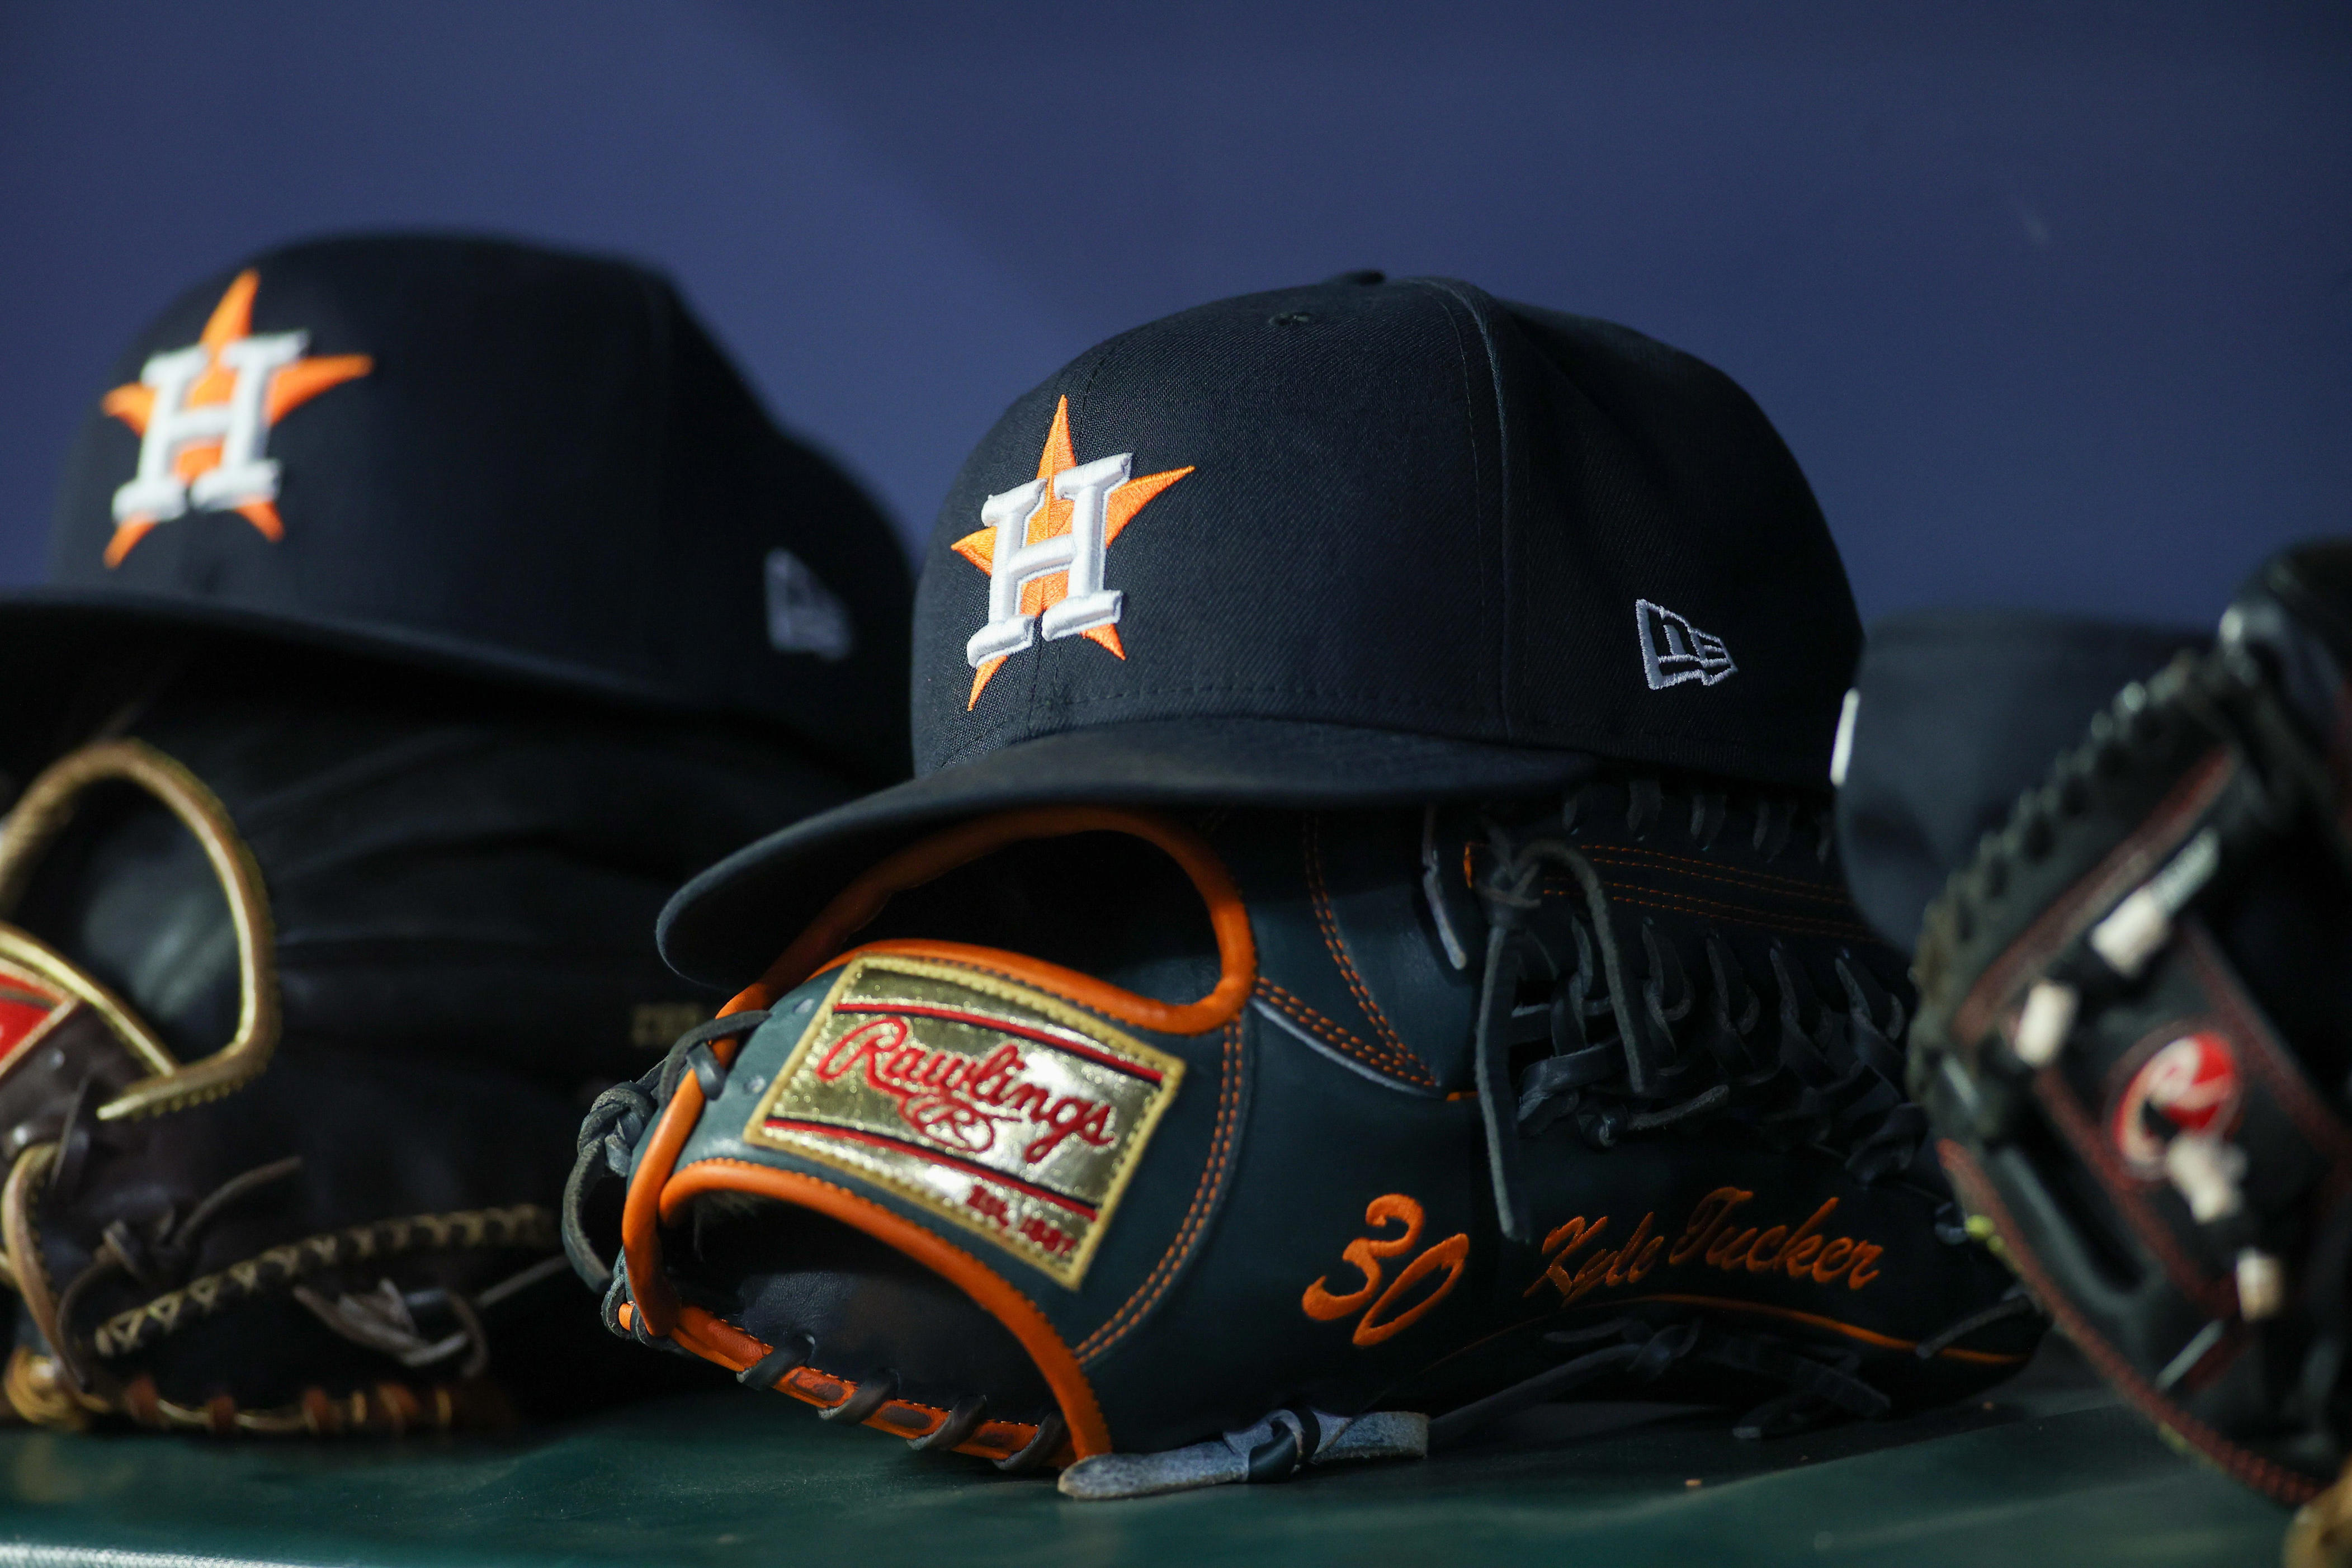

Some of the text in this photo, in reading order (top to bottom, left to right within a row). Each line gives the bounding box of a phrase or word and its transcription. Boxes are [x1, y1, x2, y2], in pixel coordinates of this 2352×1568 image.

[112, 329, 309, 523] H
[966, 452, 1132, 668] H
[816, 1016, 1116, 1164] Rawlings
[1301, 1193, 1469, 1345] 30
[1522, 1187, 1883, 1307] Kyle Tucker
